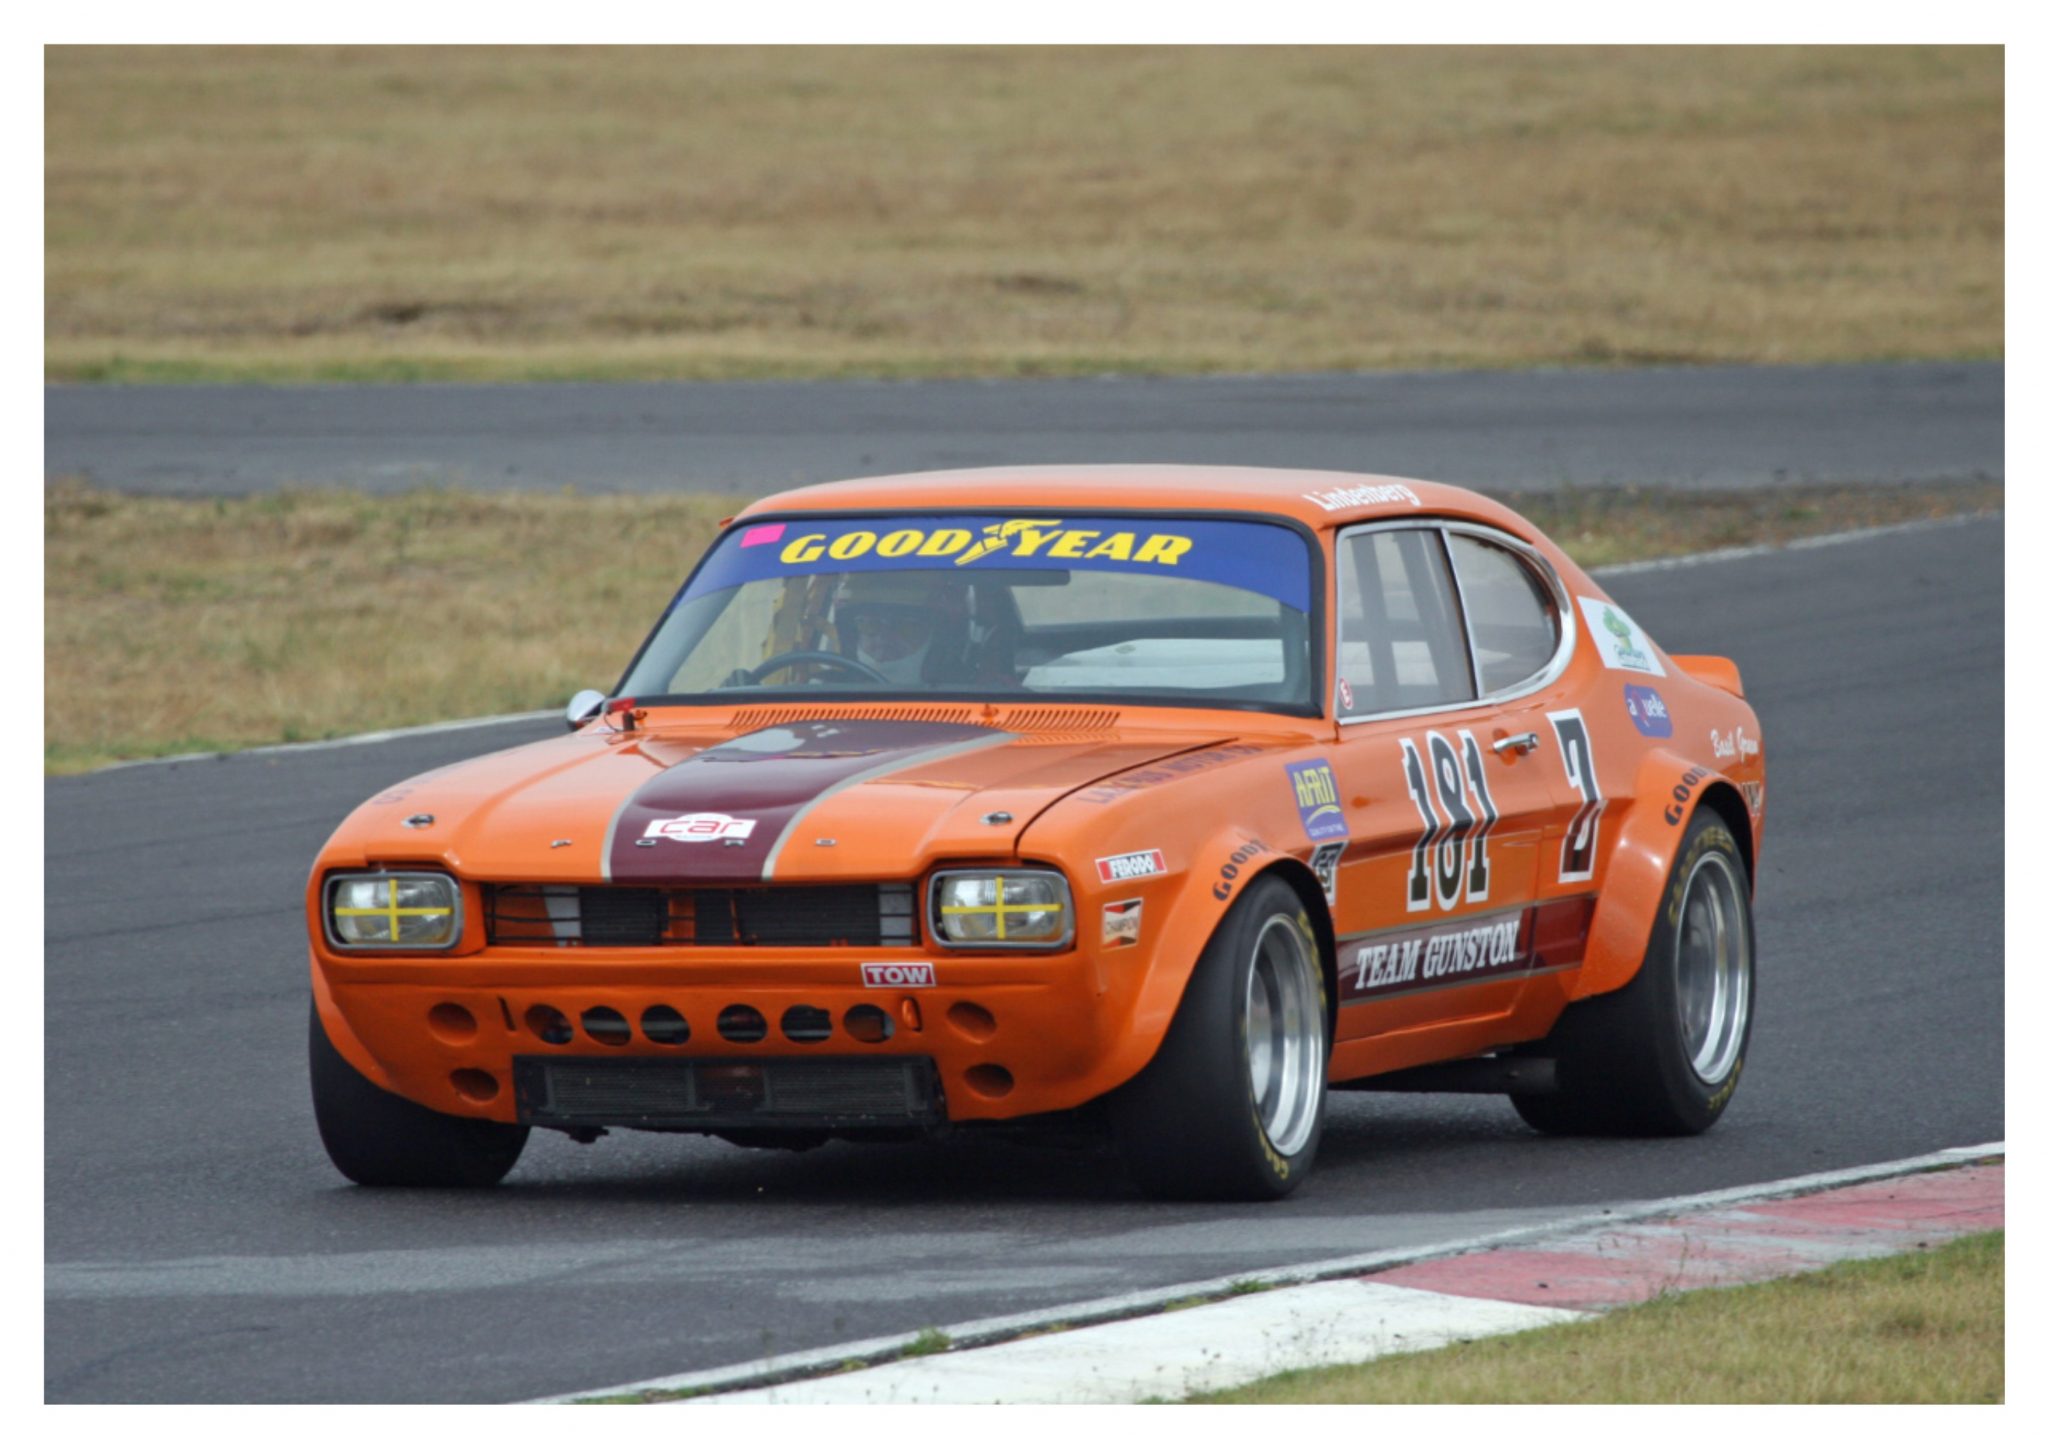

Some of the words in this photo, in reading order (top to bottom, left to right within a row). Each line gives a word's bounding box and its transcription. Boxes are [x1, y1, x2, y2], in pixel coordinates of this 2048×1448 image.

[1301, 483, 1421, 511] Lindenberg
[780, 527, 1193, 565] GOODYEAR
[1664, 767, 1718, 826] GOOD
[659, 820, 744, 834] car
[1398, 730, 1498, 912] 181
[1108, 852, 1157, 879] FERODO
[1354, 938, 1422, 989] TEAM
[1422, 919, 1521, 978] GUNSTON
[867, 967, 929, 983] TOW
